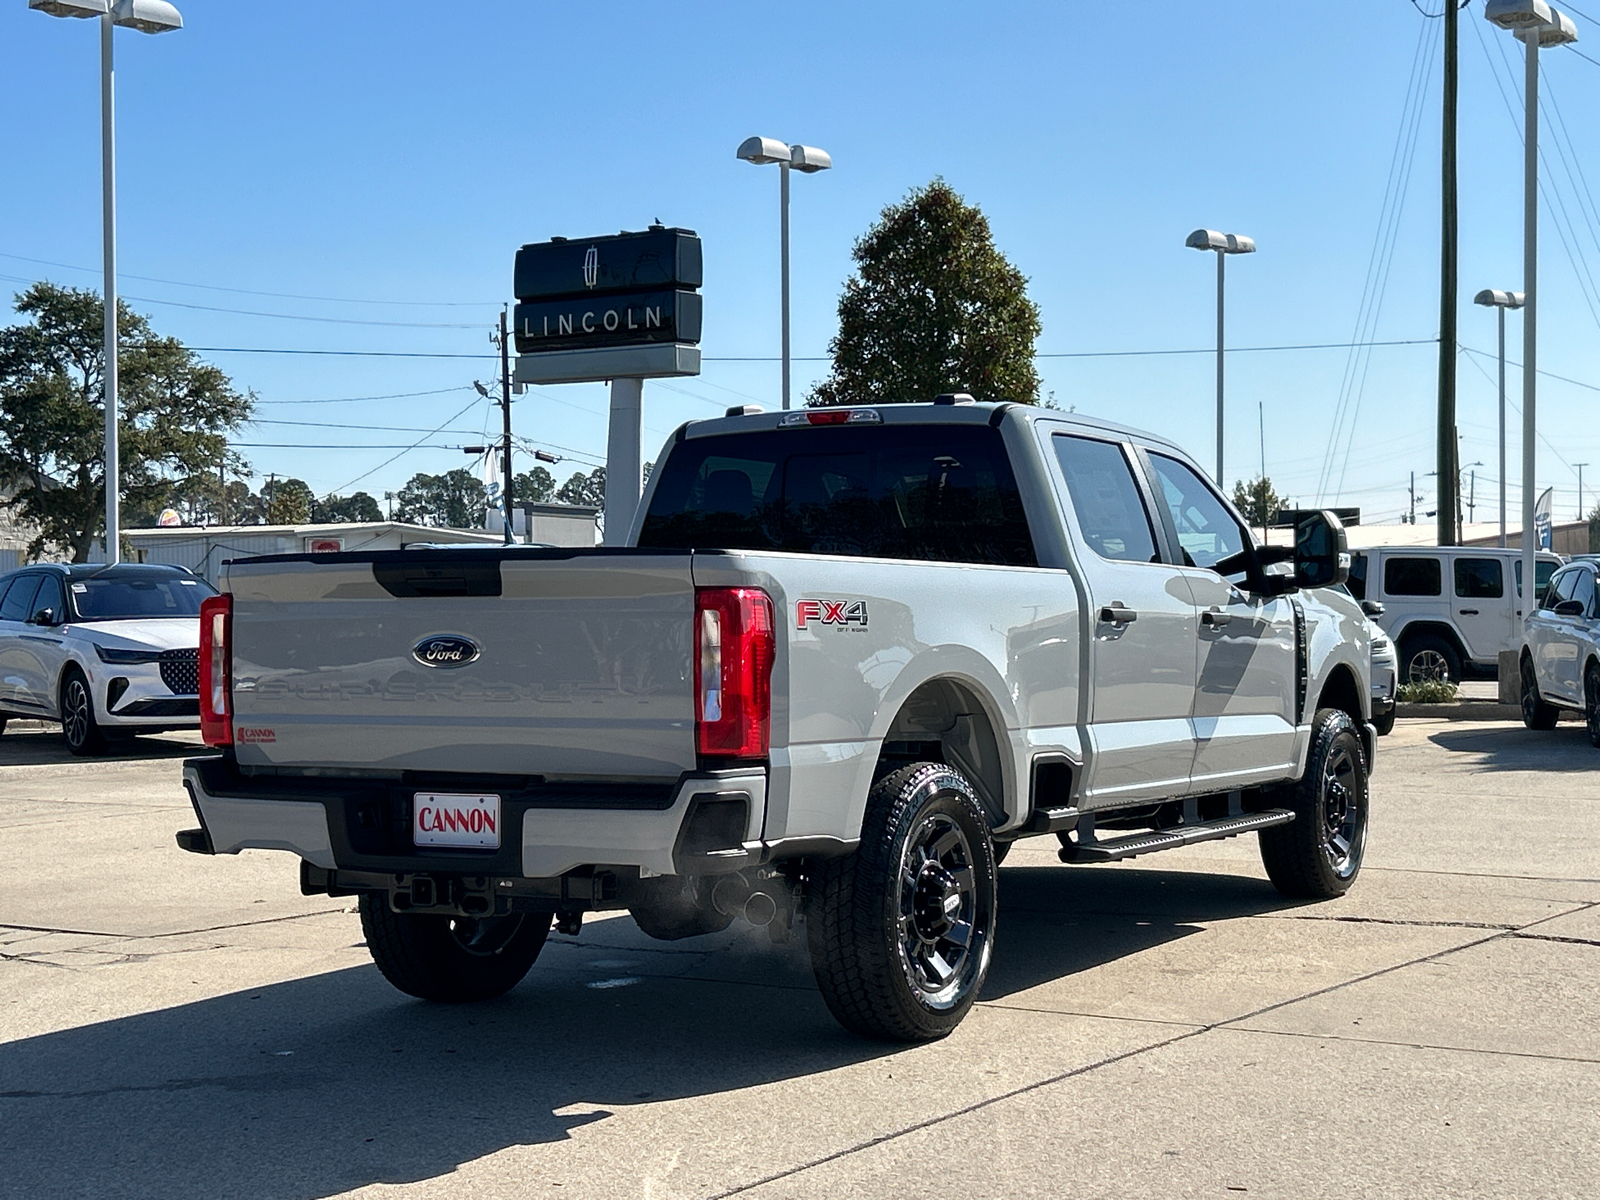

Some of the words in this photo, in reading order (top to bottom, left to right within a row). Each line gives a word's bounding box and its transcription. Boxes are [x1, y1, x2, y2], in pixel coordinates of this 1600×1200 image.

[524, 306, 661, 338] LINCOLN
[796, 599, 869, 631] FX4
[426, 641, 464, 660] Ford
[255, 680, 462, 702] SUPER
[483, 681, 663, 704] DUTY
[245, 728, 275, 738] CANNON
[418, 806, 496, 834] CANNON
